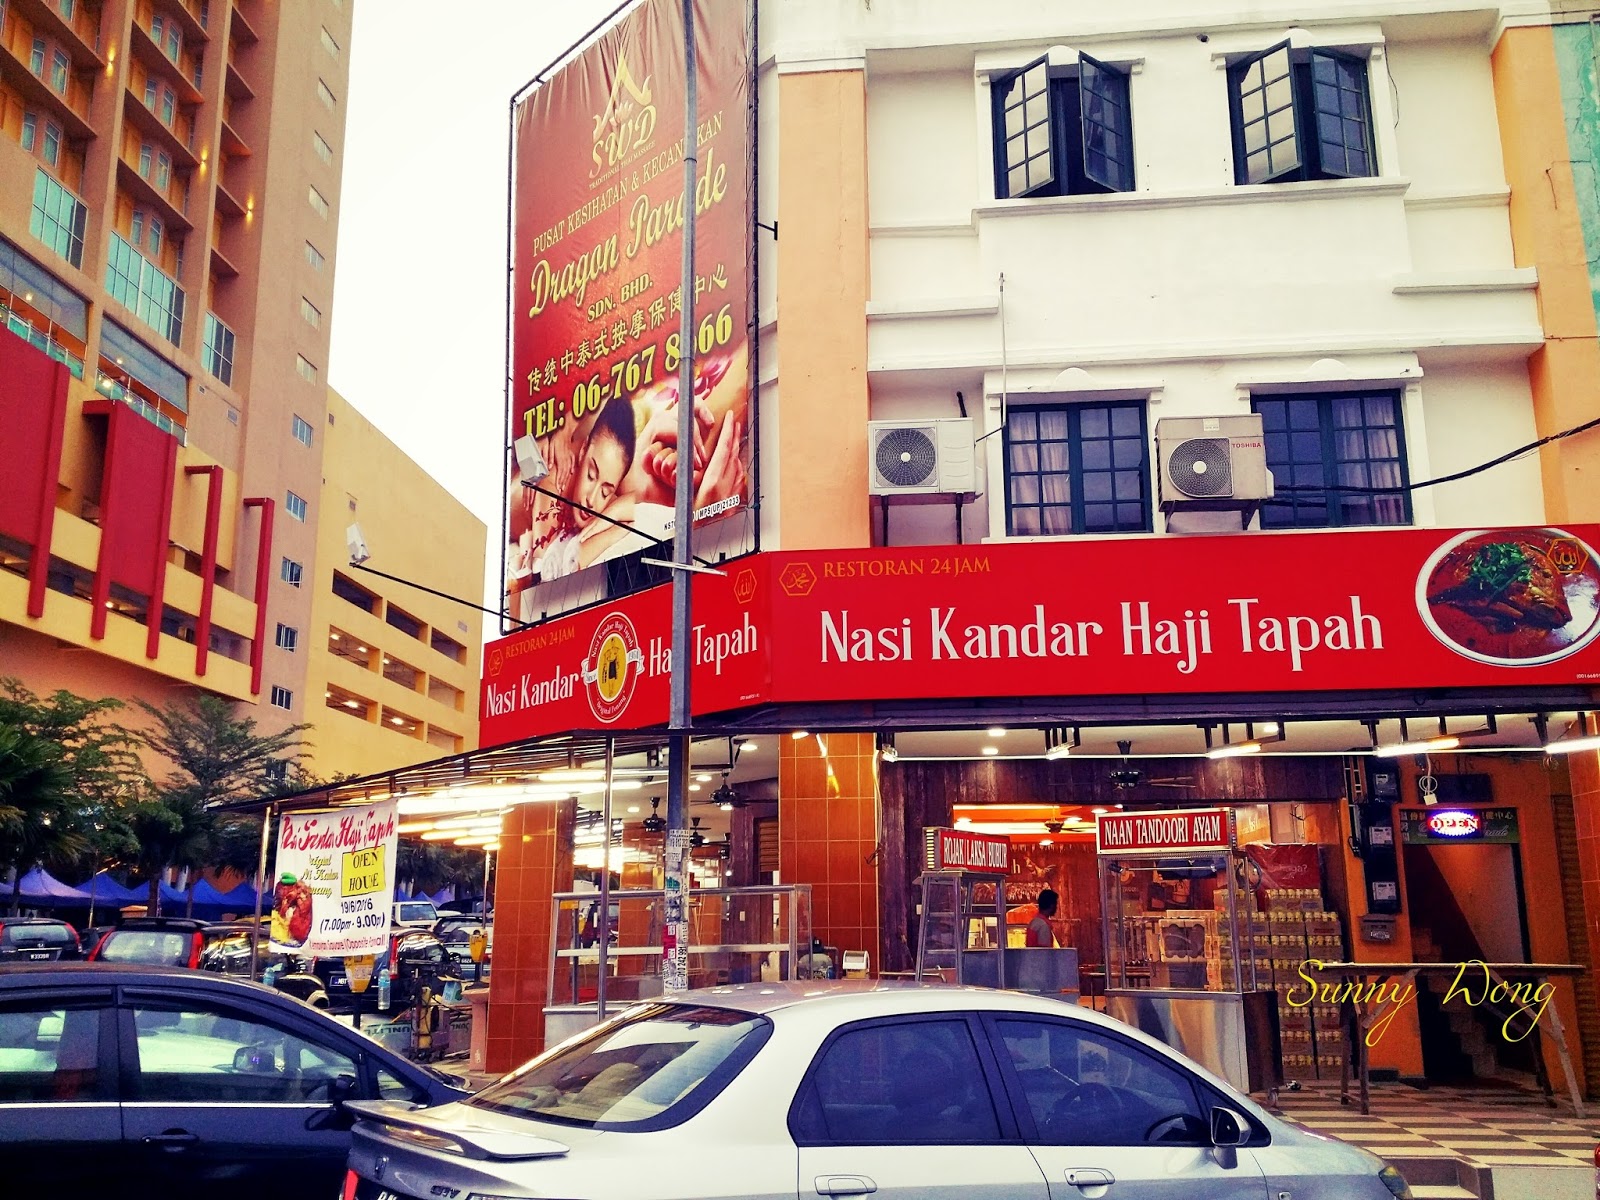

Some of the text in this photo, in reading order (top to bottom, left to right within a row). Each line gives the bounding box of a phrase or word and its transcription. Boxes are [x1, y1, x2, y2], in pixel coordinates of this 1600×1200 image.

[532, 110, 723, 258] PUSAT KESIHATAN & KECANKAN
[529, 233, 619, 319] Dragon
[587, 272, 654, 322] SDN. BHD.
[522, 303, 734, 438] TEL: 06-767 866
[823, 558, 925, 578] RESTORAN
[505, 636, 548, 659] RESTORAN
[820, 595, 1384, 674] Nasi Kandar Haji Tapah
[485, 683, 517, 718] Nasi
[520, 665, 580, 710] Kandar
[692, 611, 758, 676] Tapah
[1104, 815, 1221, 846] NAAN TANDOORI AYAM
[1430, 818, 1479, 830] OPEN
[966, 839, 987, 867] LAKSA
